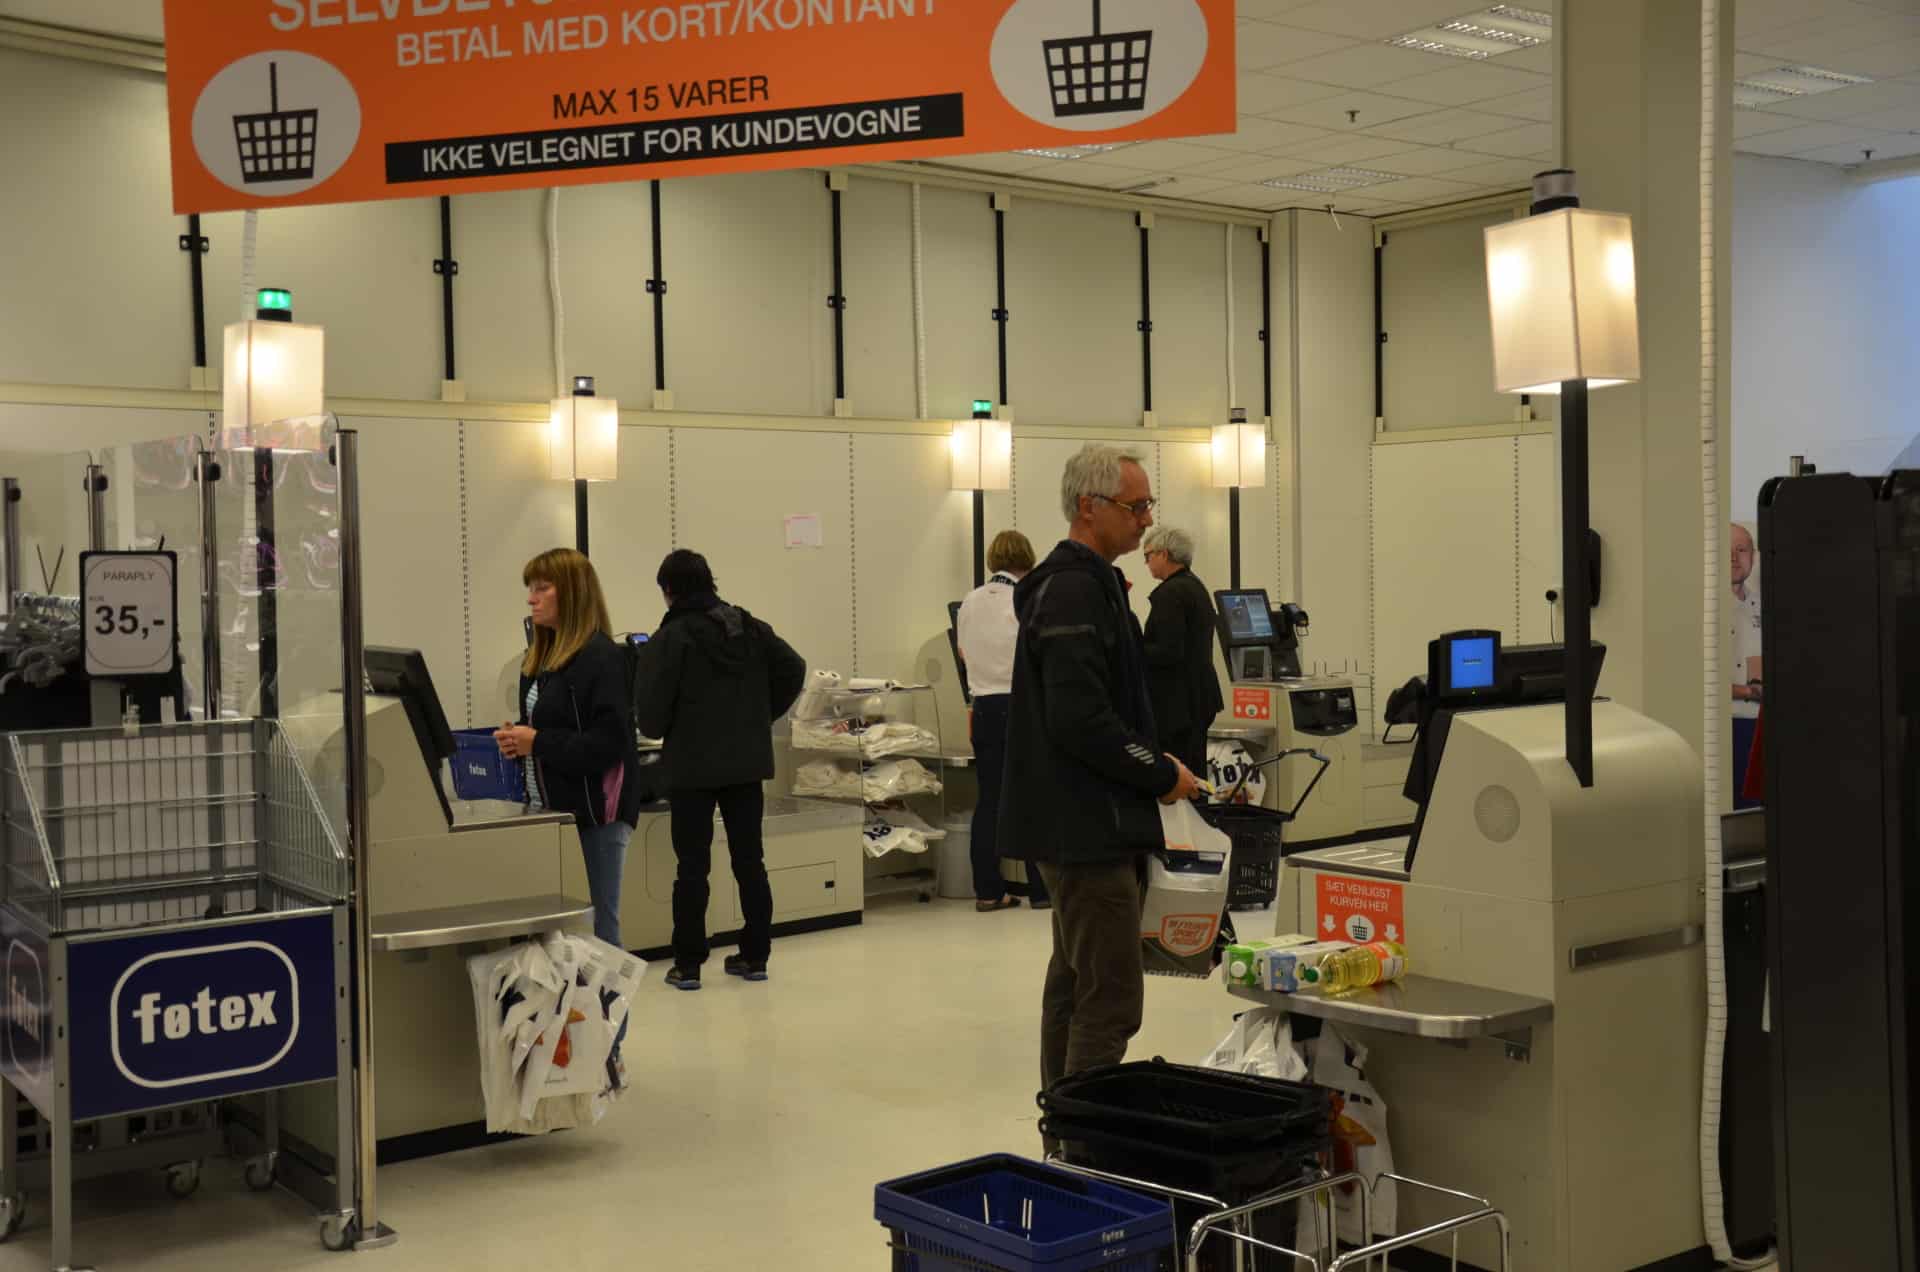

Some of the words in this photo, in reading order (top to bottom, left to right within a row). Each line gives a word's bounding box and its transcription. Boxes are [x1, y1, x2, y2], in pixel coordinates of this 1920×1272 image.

[397, 25, 512, 66] BETAL
[523, 15, 609, 55] MED
[553, 88, 617, 119] MAX
[627, 86, 661, 113] 15
[669, 76, 769, 108] VARER
[422, 145, 484, 173] IKKE
[490, 132, 636, 167] VELEGNET
[643, 128, 702, 155] FOR
[710, 106, 921, 151] KUNDEVOGNE
[103, 571, 155, 581] PARAPLY
[95, 605, 165, 640] 35,-
[1330, 895, 1367, 910] KURVEN
[1369, 900, 1389, 912] HER
[1346, 883, 1391, 899] VENLIGST
[132, 986, 277, 1044] føtex
